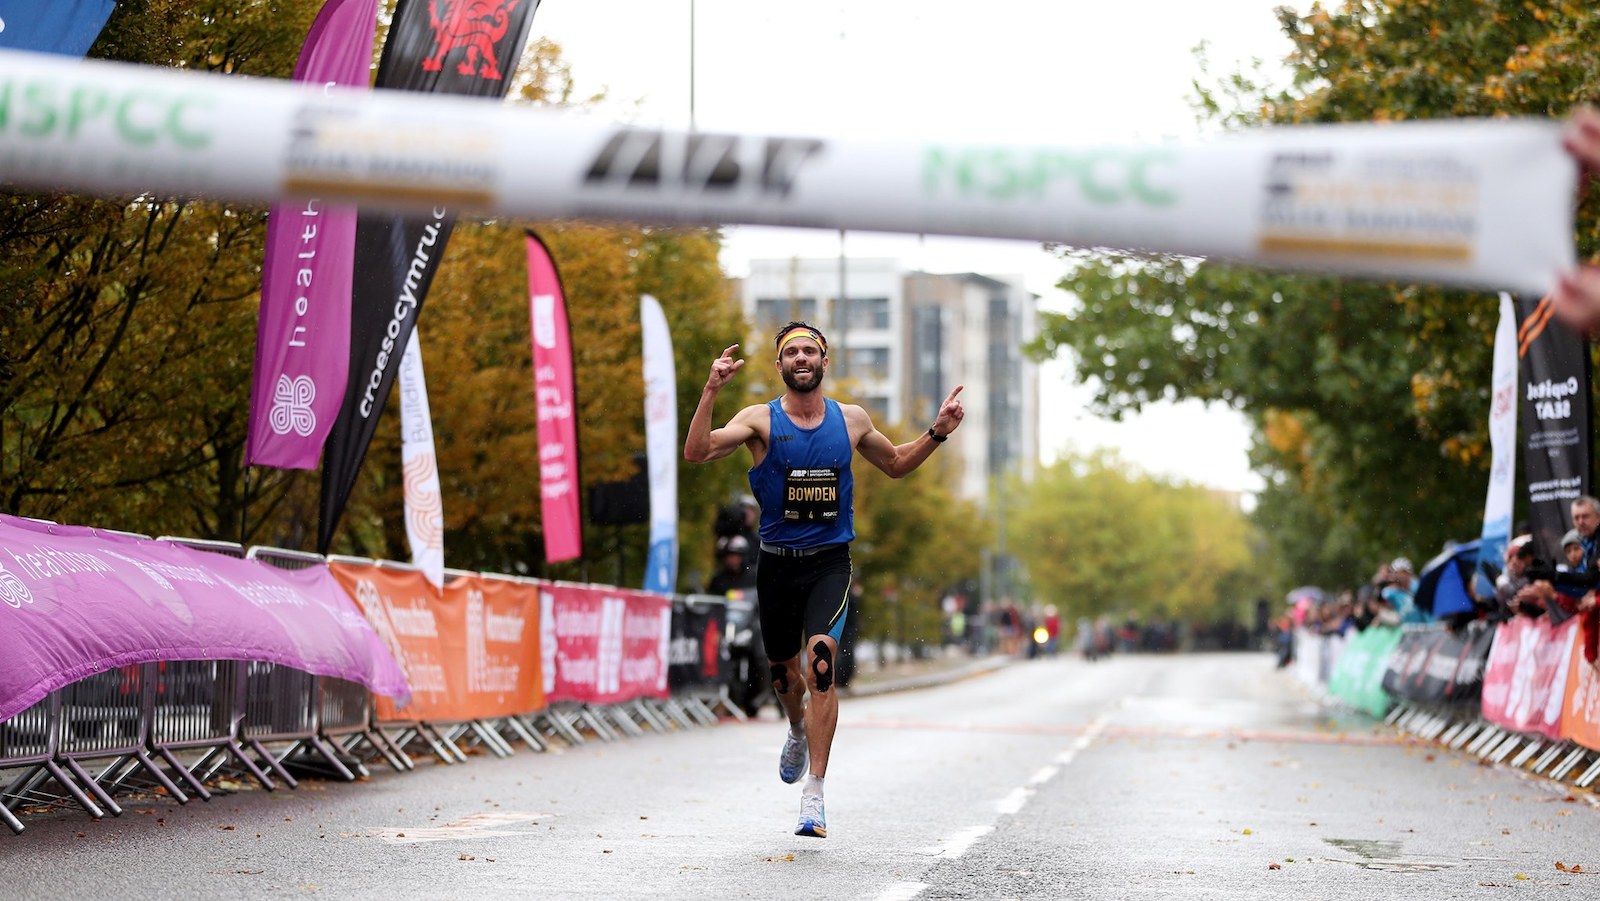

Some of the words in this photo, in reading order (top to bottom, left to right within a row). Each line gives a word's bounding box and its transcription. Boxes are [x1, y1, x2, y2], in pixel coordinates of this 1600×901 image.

[359, 204, 446, 419] croesocymru.c
[788, 486, 836, 501] BOWDEN
[808, 510, 814, 519] 4
